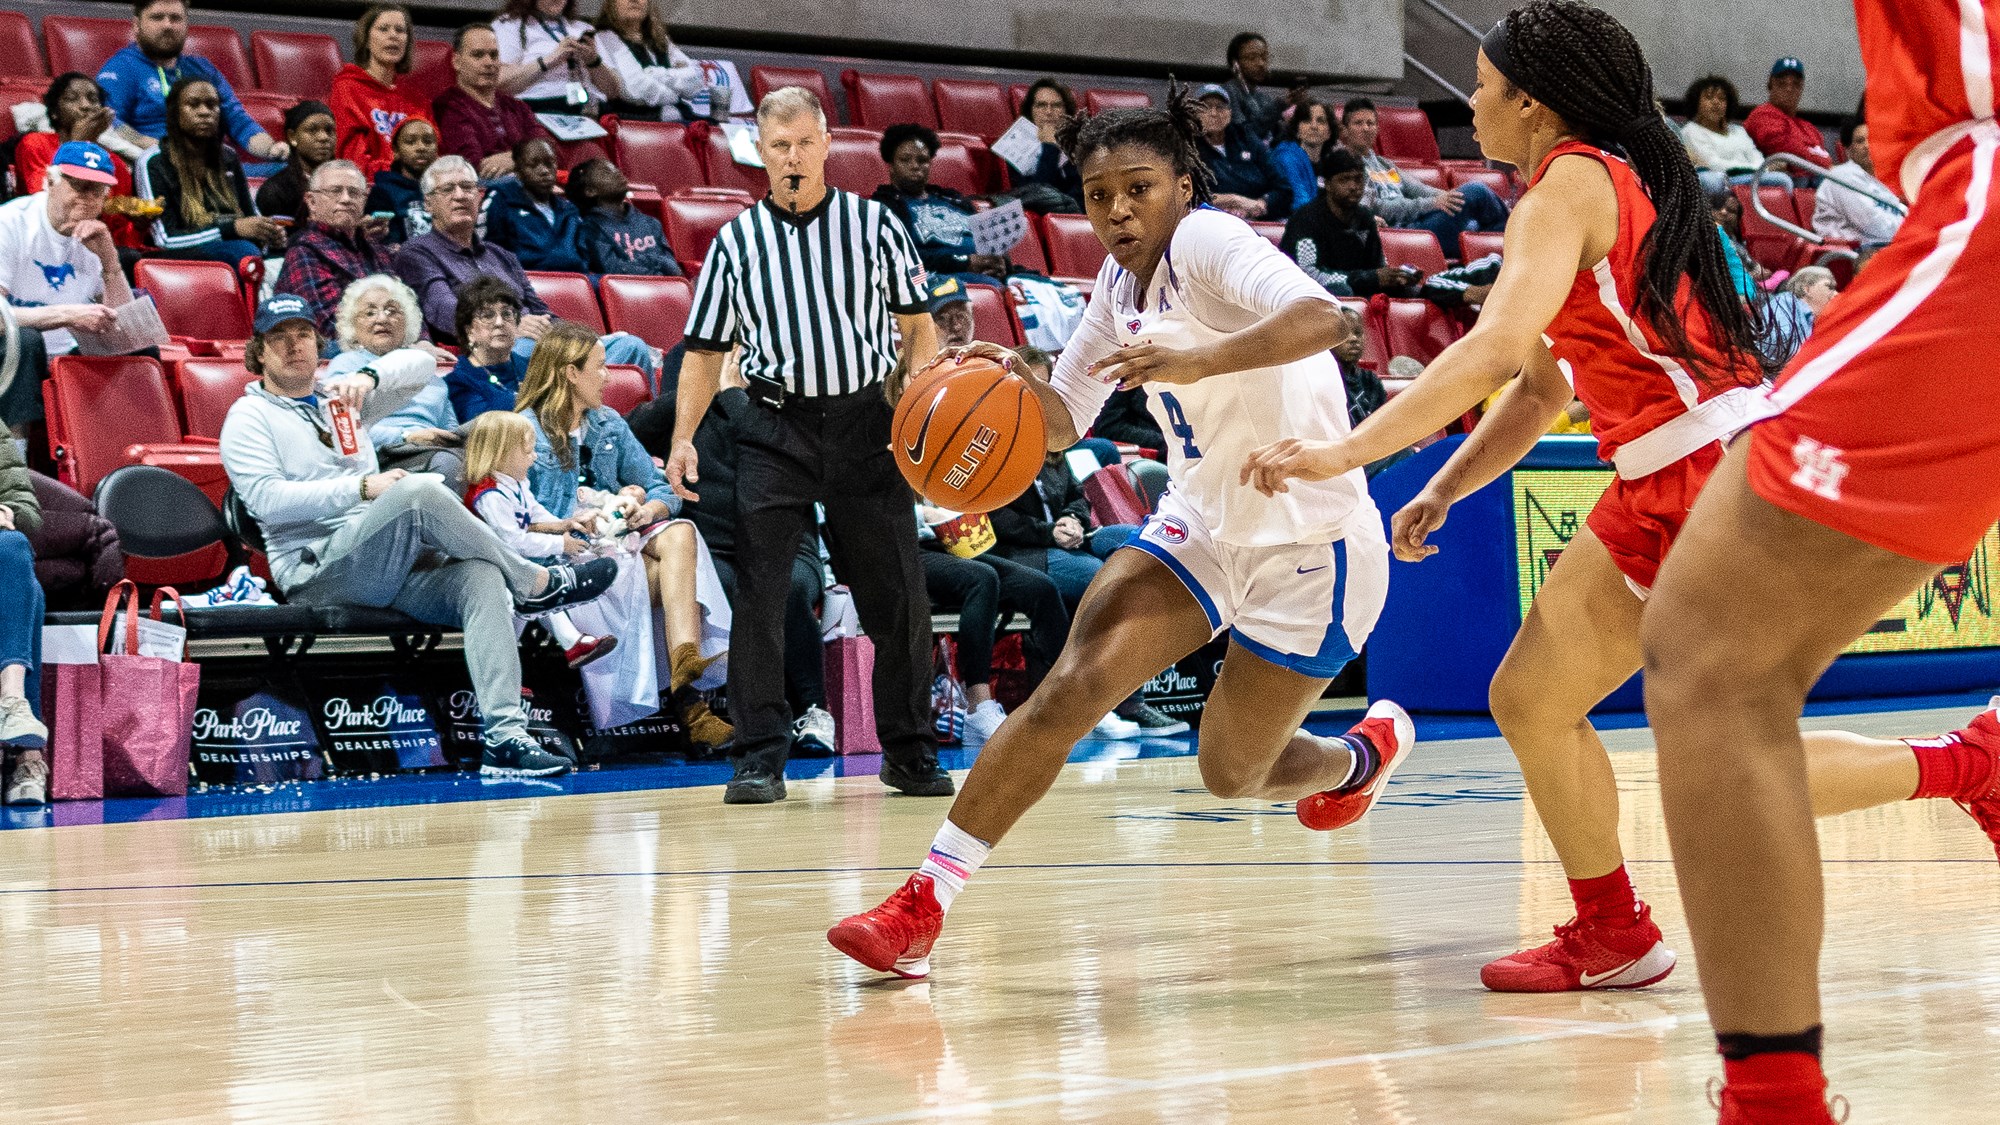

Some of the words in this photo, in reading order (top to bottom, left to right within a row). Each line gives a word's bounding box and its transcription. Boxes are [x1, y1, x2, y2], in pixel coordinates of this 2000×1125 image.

[84, 151, 101, 168] T
[1159, 391, 1203, 459] 4
[943, 423, 997, 490] ELITE
[193, 709, 243, 740] Park
[242, 707, 301, 740] Place
[324, 698, 373, 729] Park
[372, 696, 426, 727] Place
[200, 750, 312, 763] DEALERSHIPS
[334, 737, 438, 751] DEALERSHIPS
